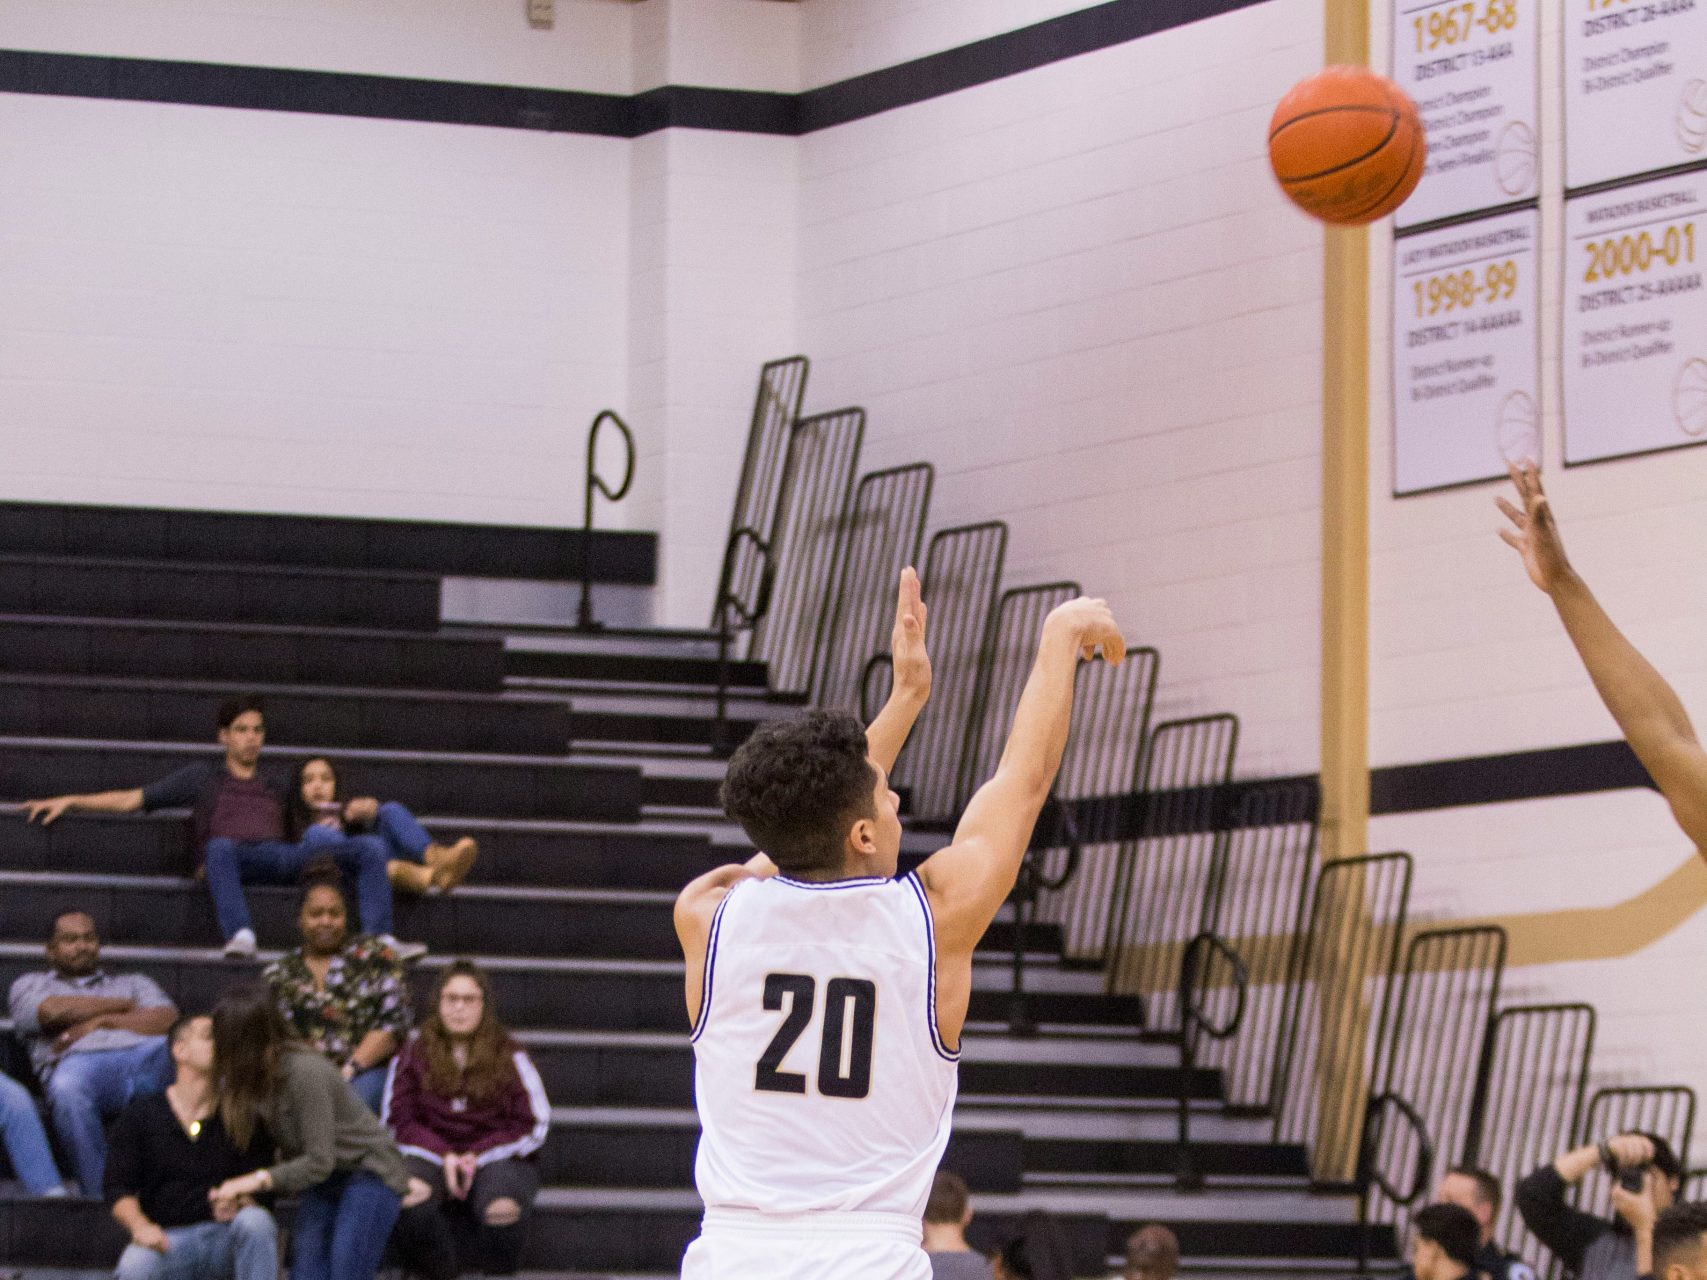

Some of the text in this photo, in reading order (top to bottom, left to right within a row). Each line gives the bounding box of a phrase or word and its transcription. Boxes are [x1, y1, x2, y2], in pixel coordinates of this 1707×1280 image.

[1413, 0, 1518, 53] 1967-68
[1583, 222, 1696, 283] 2000-01
[1413, 259, 1518, 320] 1998-99
[753, 970, 880, 1100] 20
